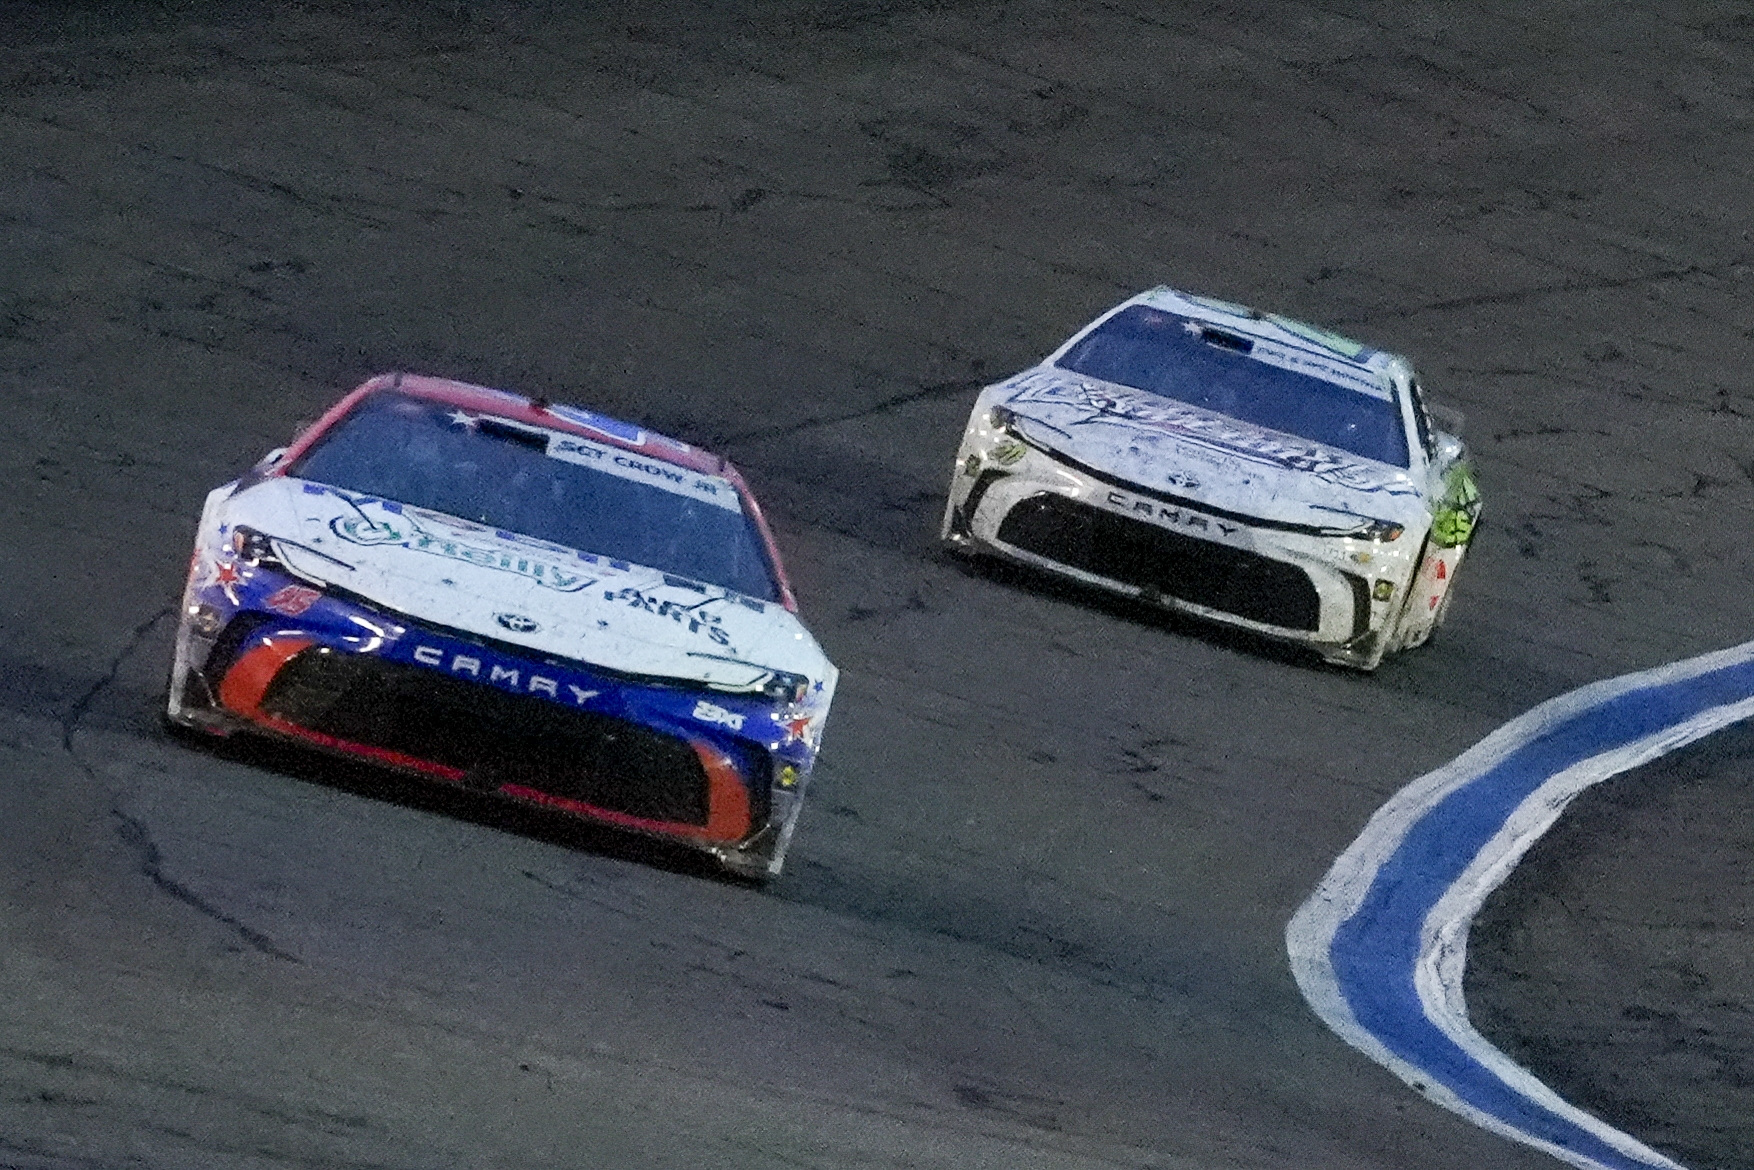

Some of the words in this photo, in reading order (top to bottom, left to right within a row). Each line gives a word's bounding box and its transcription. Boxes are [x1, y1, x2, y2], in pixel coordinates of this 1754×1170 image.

[613, 456, 684, 485] CROW
[1107, 491, 1238, 537] CAMRY
[413, 645, 600, 705] CAMRY
